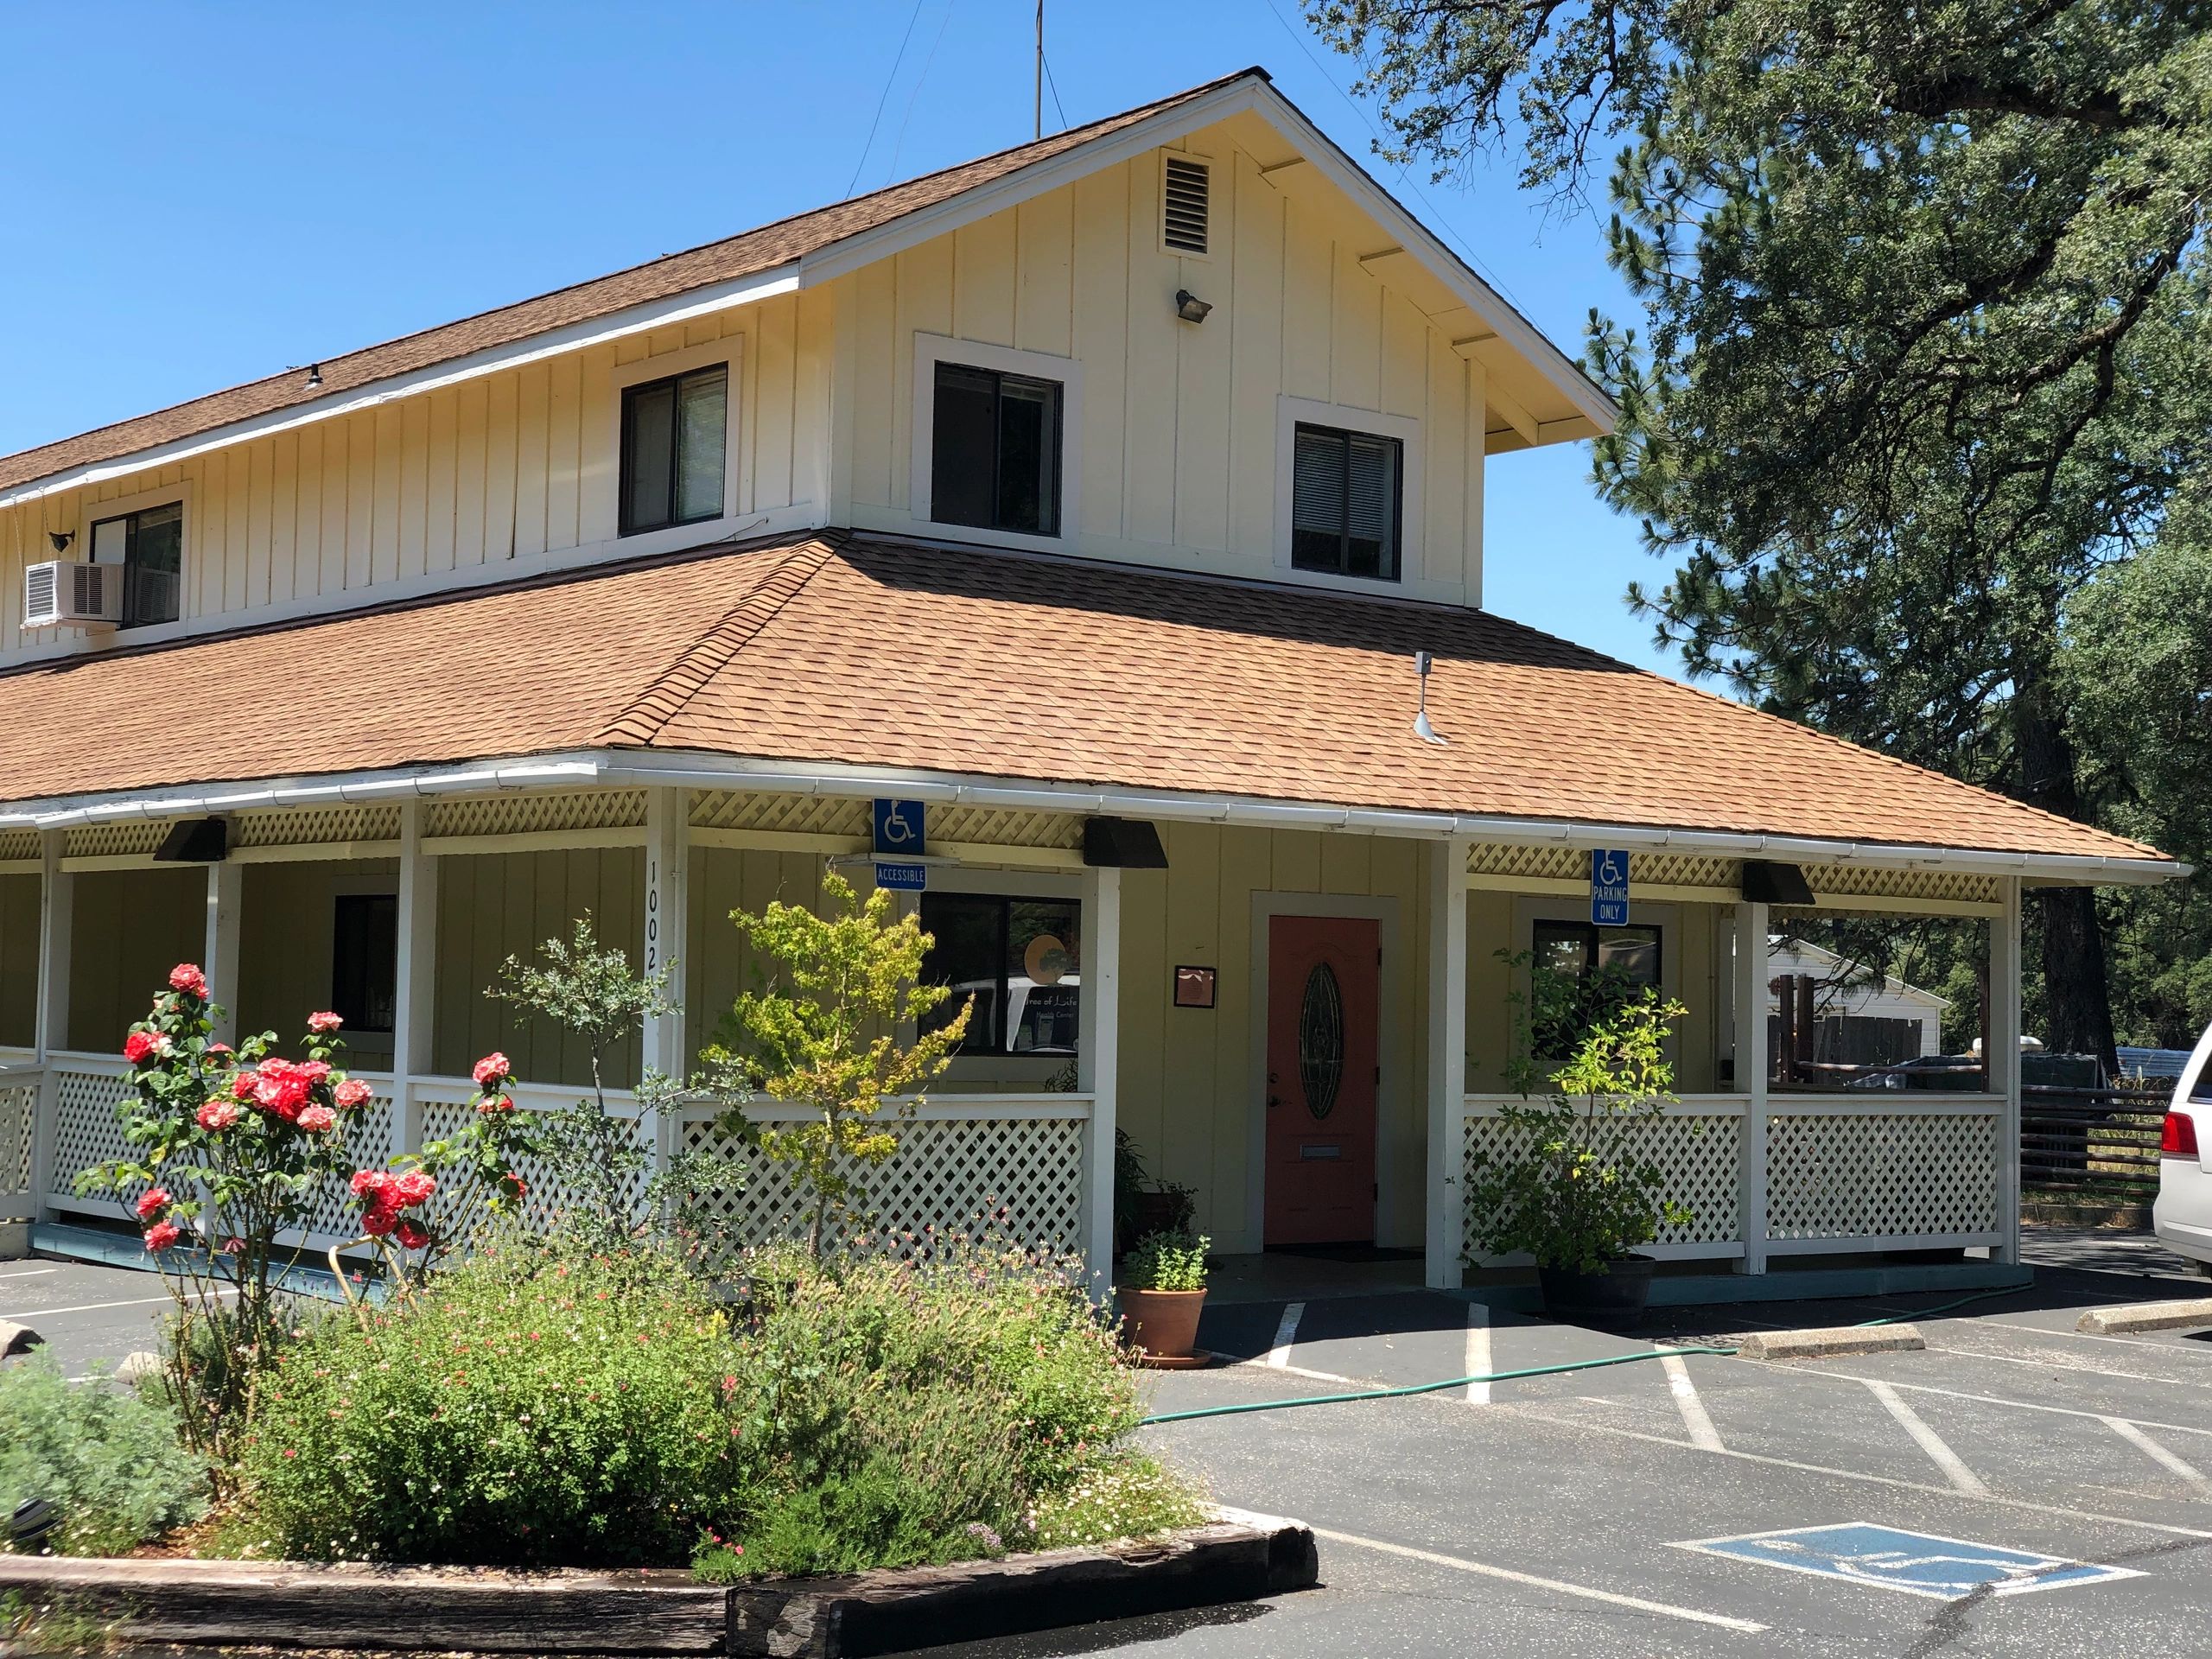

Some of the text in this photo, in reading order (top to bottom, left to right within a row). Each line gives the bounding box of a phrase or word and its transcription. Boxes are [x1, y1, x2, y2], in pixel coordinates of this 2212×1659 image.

[878, 868, 925, 882] ACCESSIBLE
[1593, 885, 1627, 902] PARKING
[648, 861, 658, 971] 1002
[1600, 904, 1620, 920] ONLY
[1043, 995, 1053, 1006] of
[1053, 995, 1077, 1007] Life
